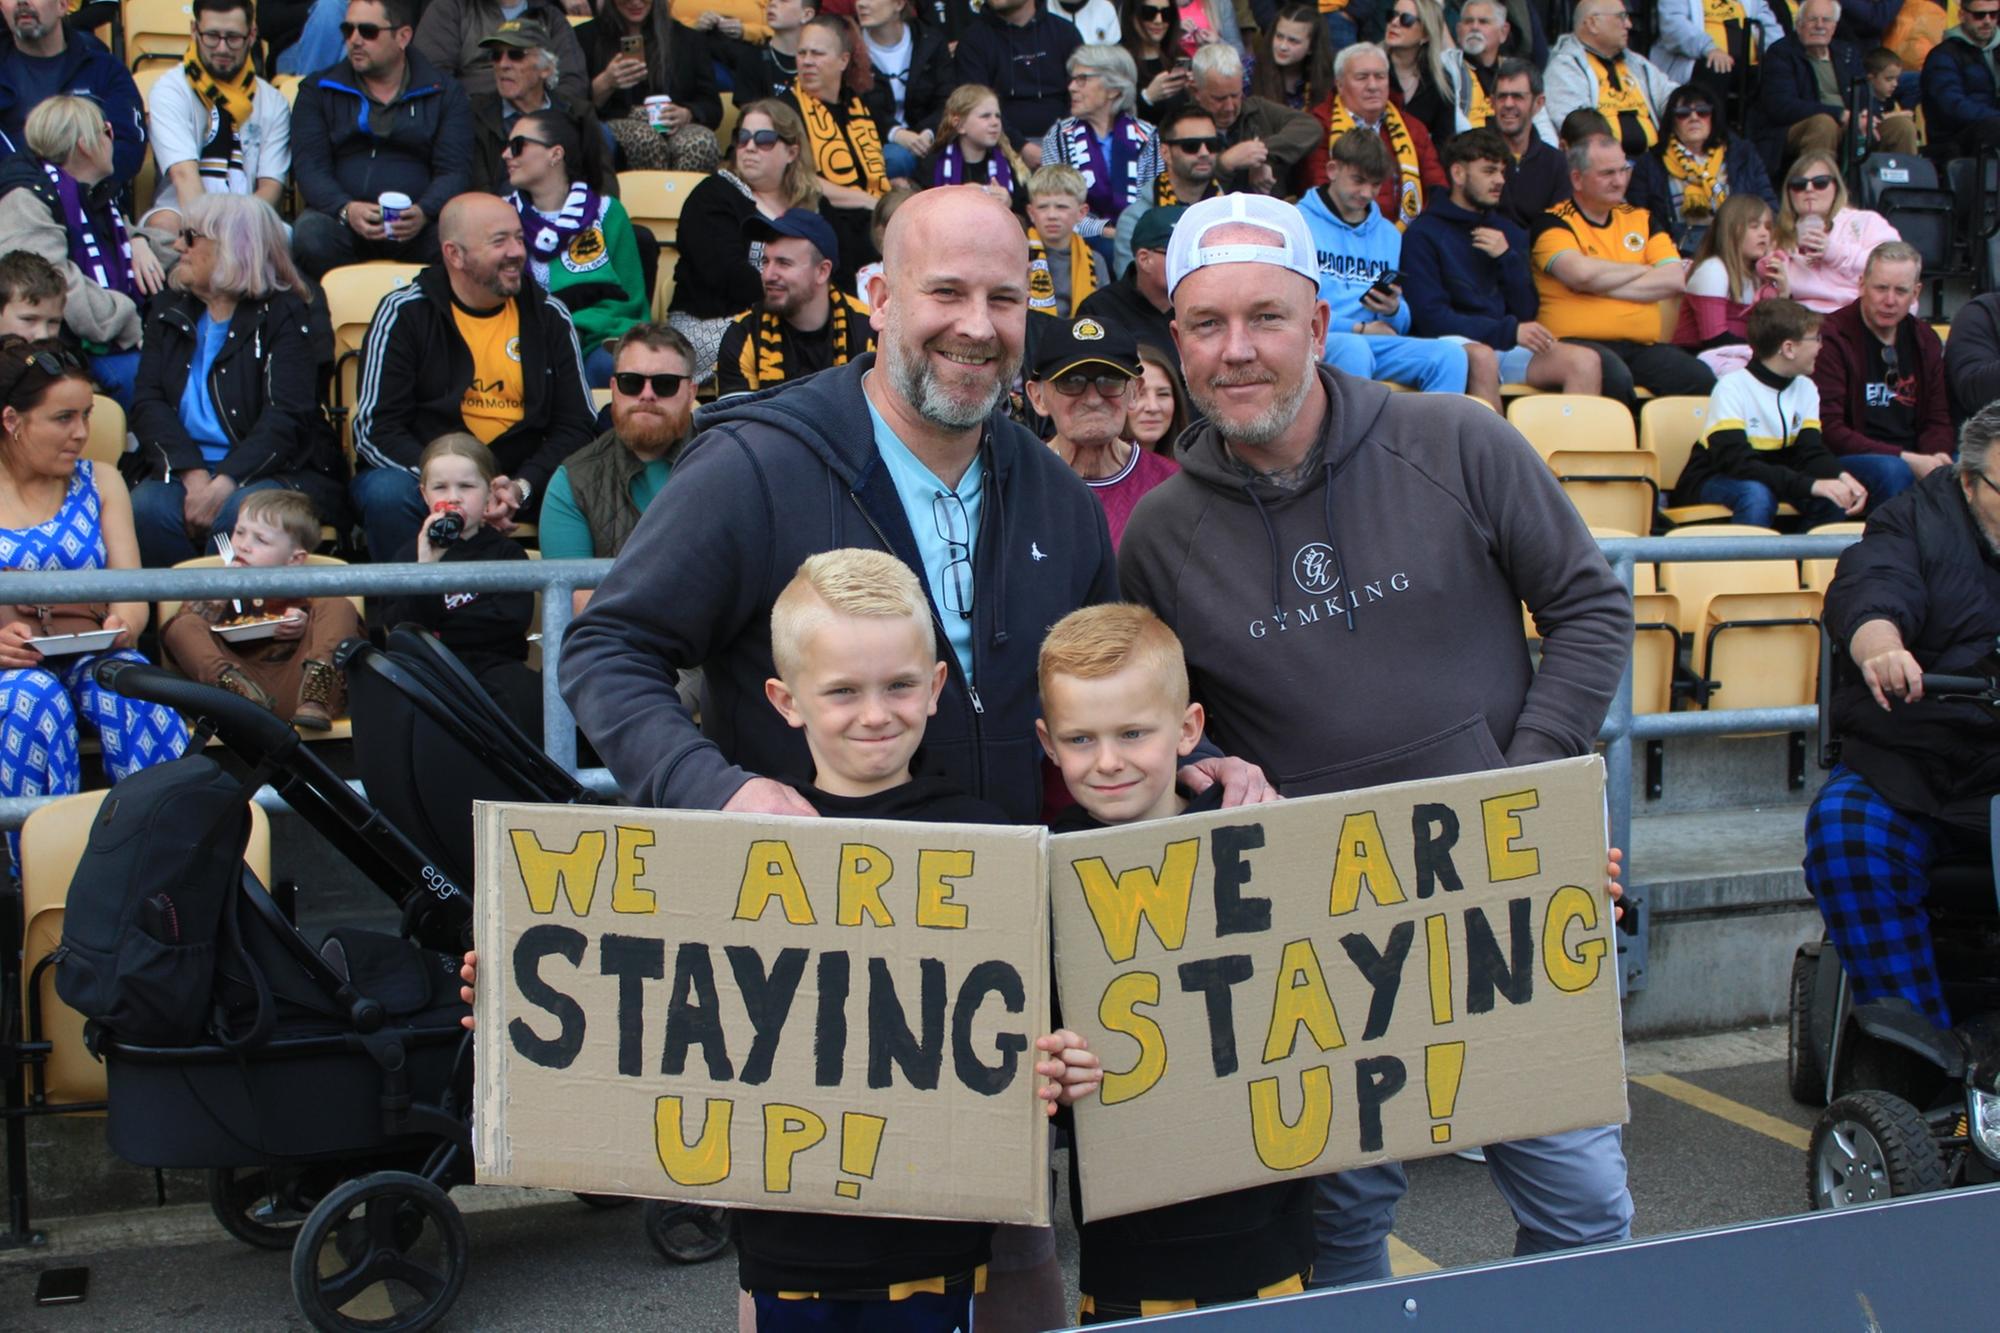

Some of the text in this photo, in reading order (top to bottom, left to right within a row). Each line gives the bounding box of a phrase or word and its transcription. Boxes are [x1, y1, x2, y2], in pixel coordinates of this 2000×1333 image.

[508, 825, 975, 929] WE ARE
[1070, 789, 1542, 965] WE ARE
[507, 923, 1028, 1096] STAYING
[1098, 885, 1608, 1105] STAYING
[654, 1095, 888, 1199] UP!
[1247, 1040, 1466, 1171] UP!
